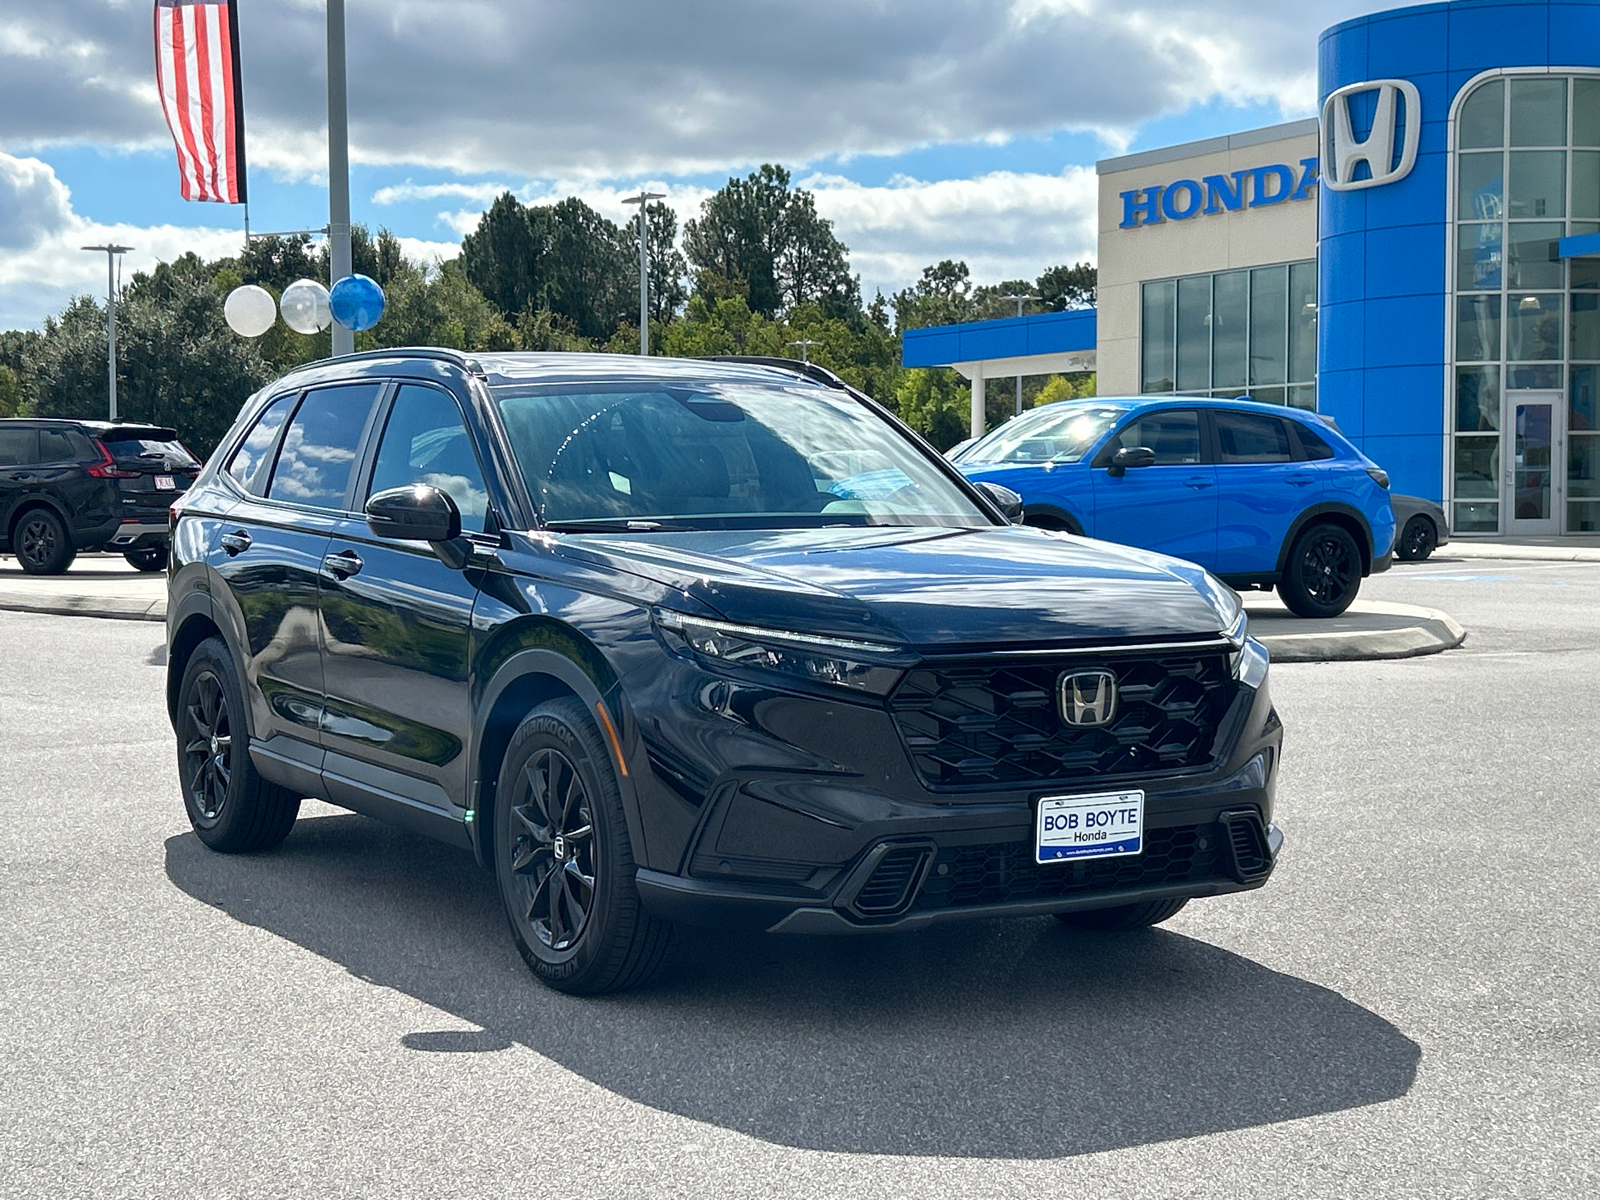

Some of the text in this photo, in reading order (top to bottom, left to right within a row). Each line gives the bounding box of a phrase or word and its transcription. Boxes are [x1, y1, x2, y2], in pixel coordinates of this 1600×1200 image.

[1044, 808, 1138, 831] BOB BOYTE
[1074, 830, 1107, 842] Honda
